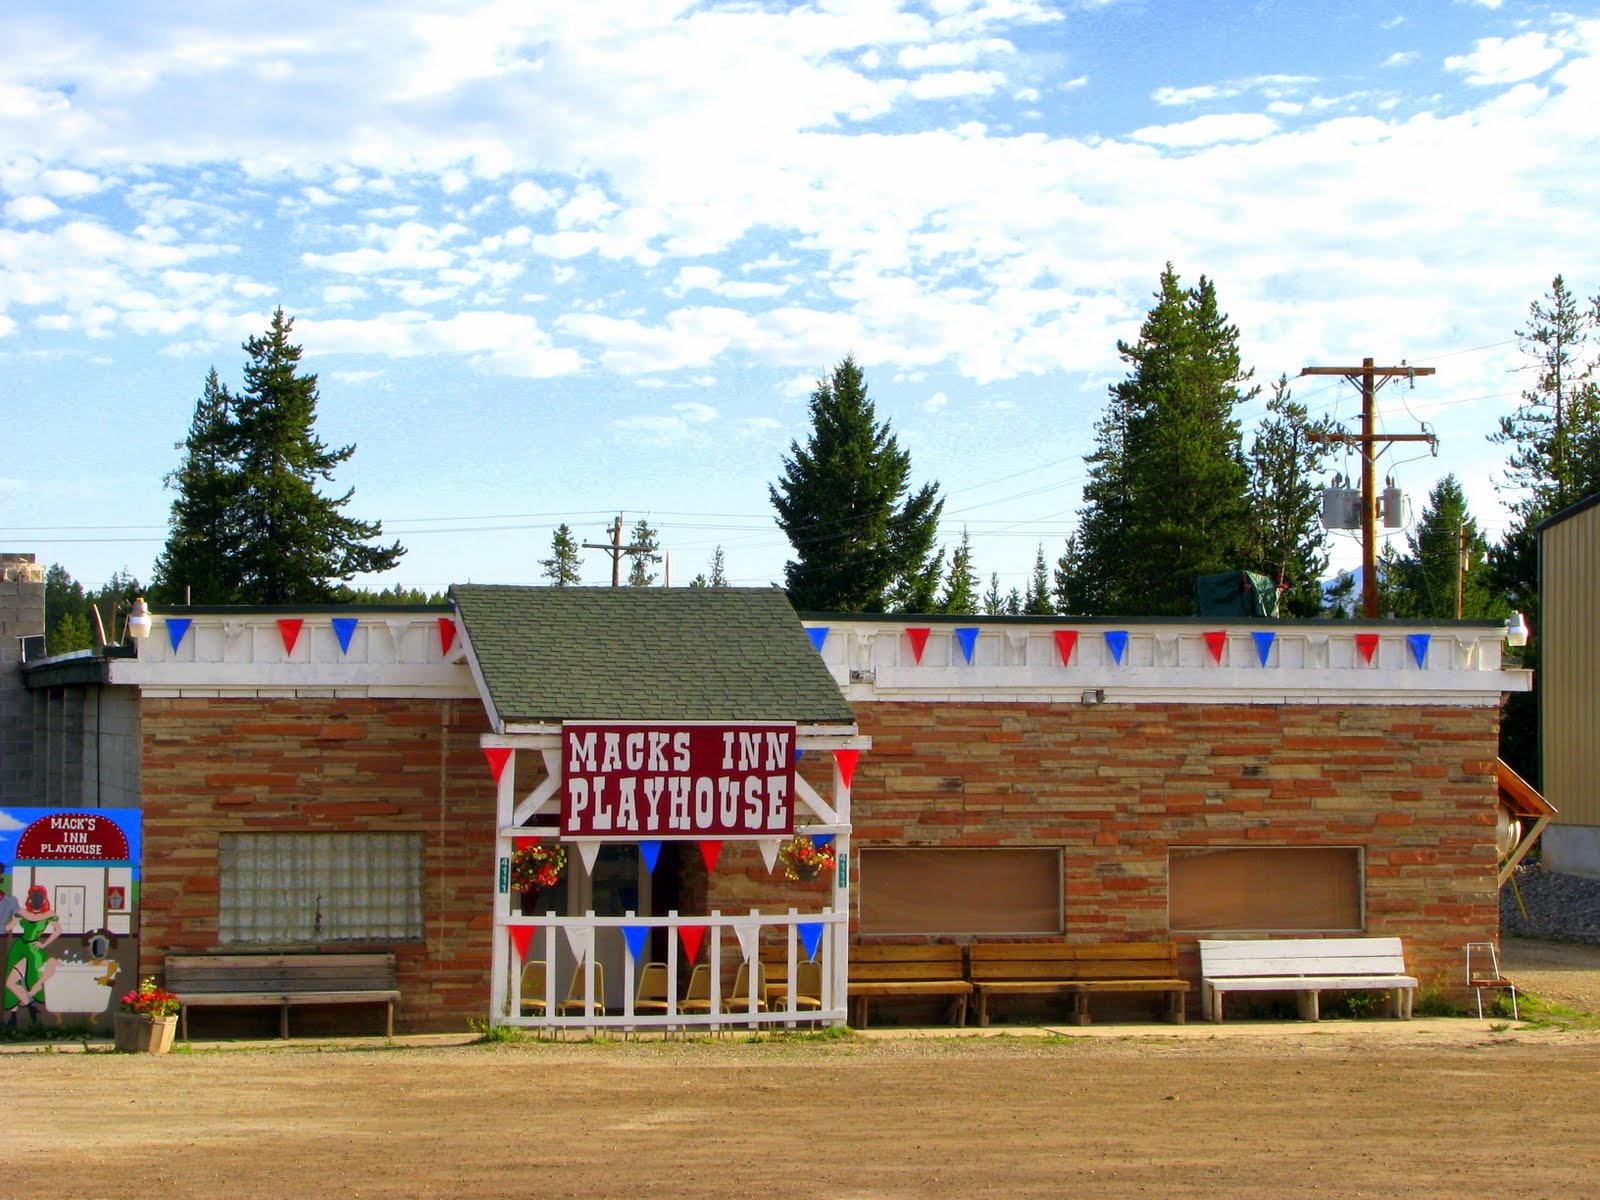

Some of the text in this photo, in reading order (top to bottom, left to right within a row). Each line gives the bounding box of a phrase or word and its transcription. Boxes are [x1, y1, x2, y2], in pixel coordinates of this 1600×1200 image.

[569, 731, 789, 772] MACKS INN
[568, 775, 787, 831] PLAYHOUSE
[50, 817, 96, 831] MACK'S
[63, 832, 88, 843] INN
[40, 843, 102, 855] PLAYHOUSE
